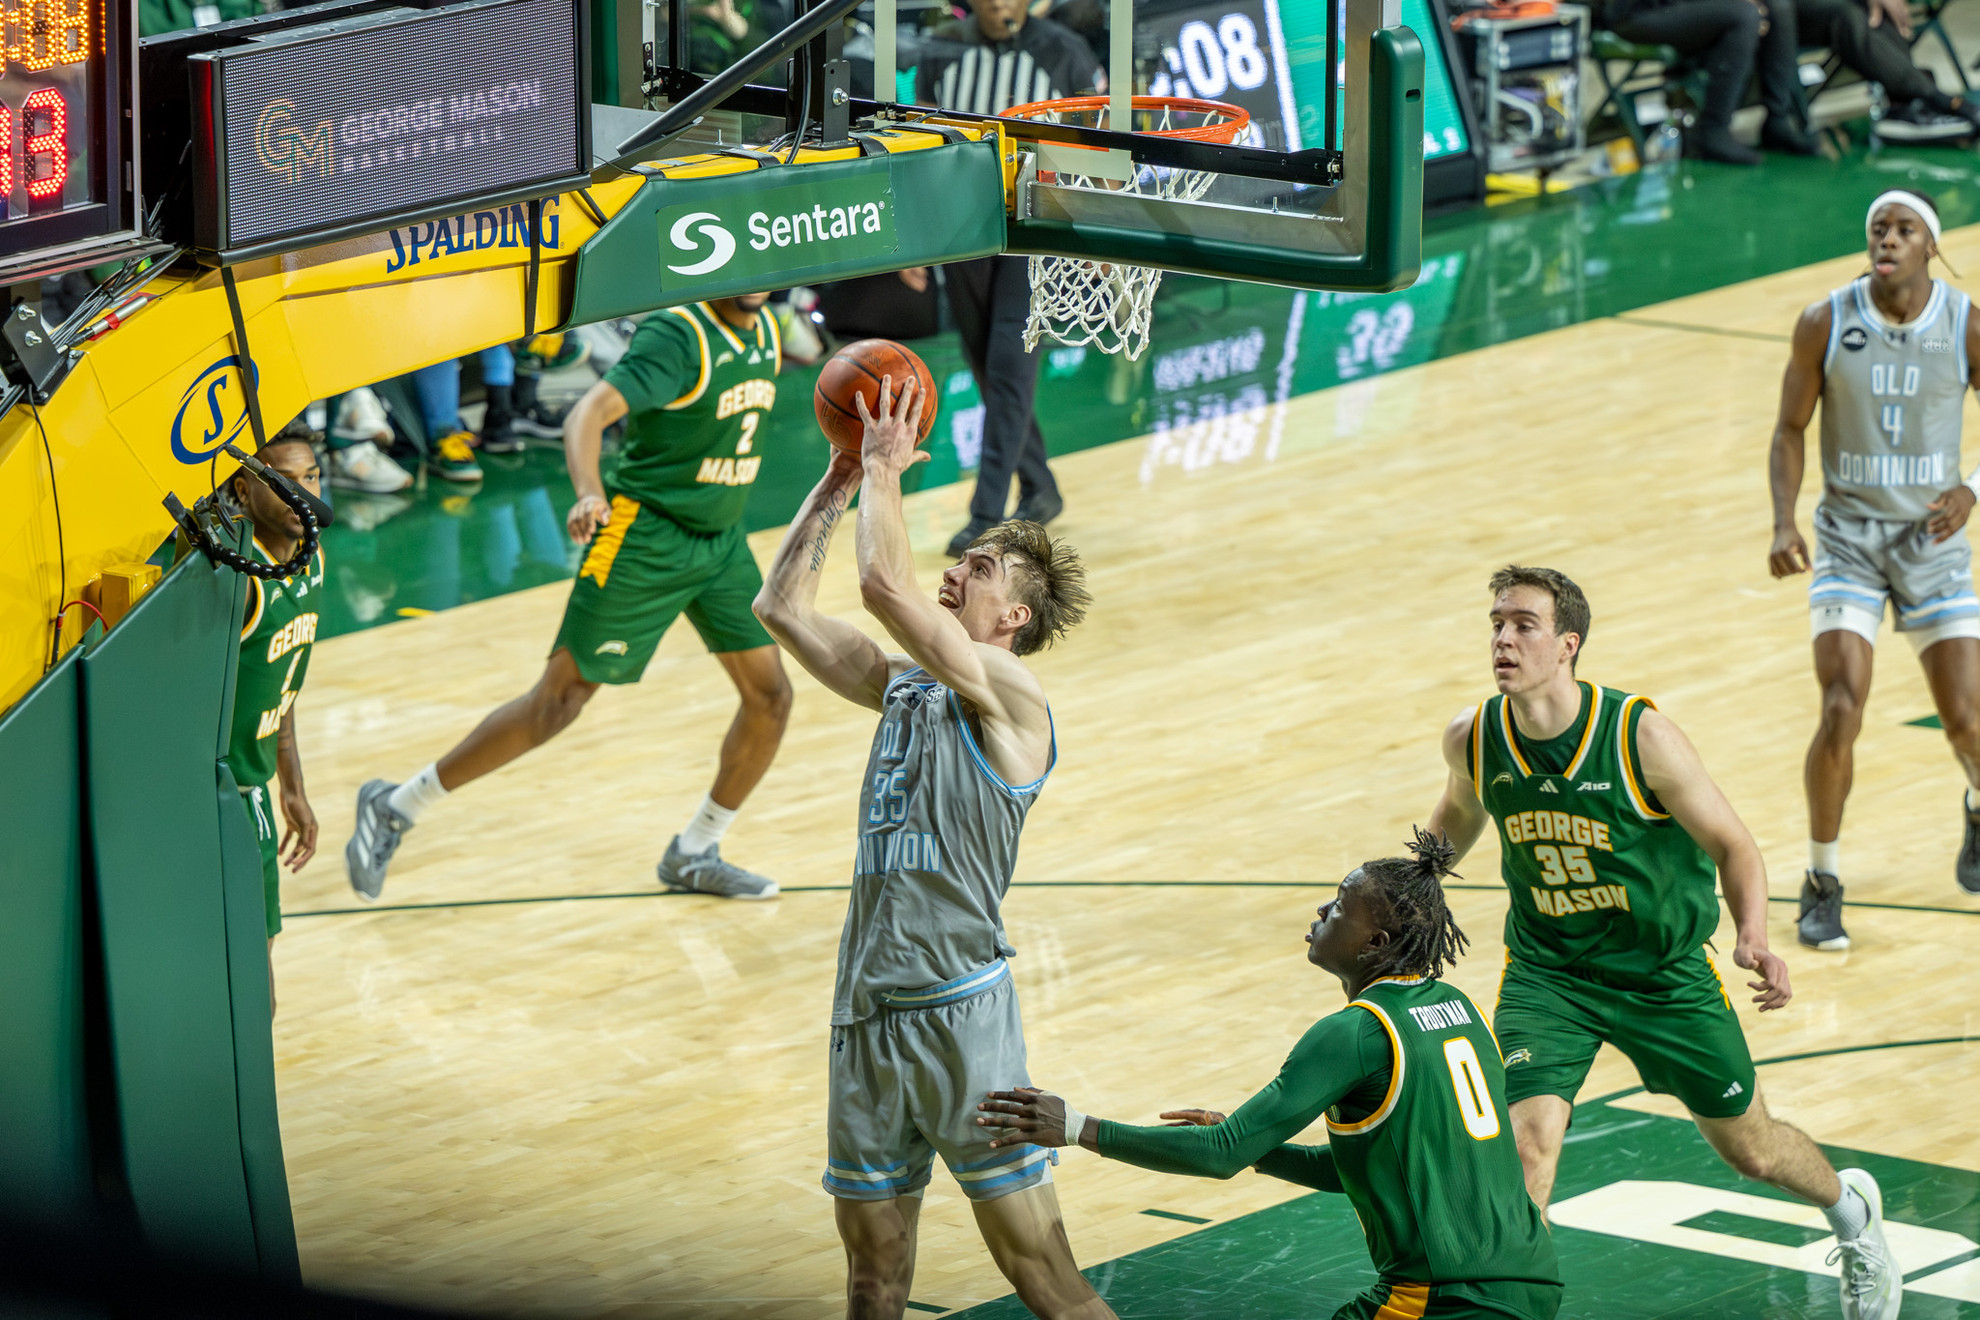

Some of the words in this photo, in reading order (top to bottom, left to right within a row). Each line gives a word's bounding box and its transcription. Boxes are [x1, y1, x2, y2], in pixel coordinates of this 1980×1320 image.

[0, 0, 90, 72] :08
[341, 99, 444, 145] GEORGE
[449, 80, 541, 123] MASON
[386, 195, 560, 274] SPALDING
[715, 378, 777, 420] GEORG
[1871, 362, 1921, 397] OLD
[735, 411, 760, 455] 2
[1881, 404, 1903, 446] 4
[1838, 452, 1944, 487] DOMINION
[267, 612, 319, 664] GEORG
[879, 720, 905, 760] OL
[868, 769, 909, 824] 35
[1504, 810, 1613, 853] GEORGE
[1534, 845, 1597, 886] 35
[1530, 884, 1630, 917] MASON
[1408, 1000, 1472, 1032] TROUTMAN
[1443, 1036, 1500, 1141] 0
